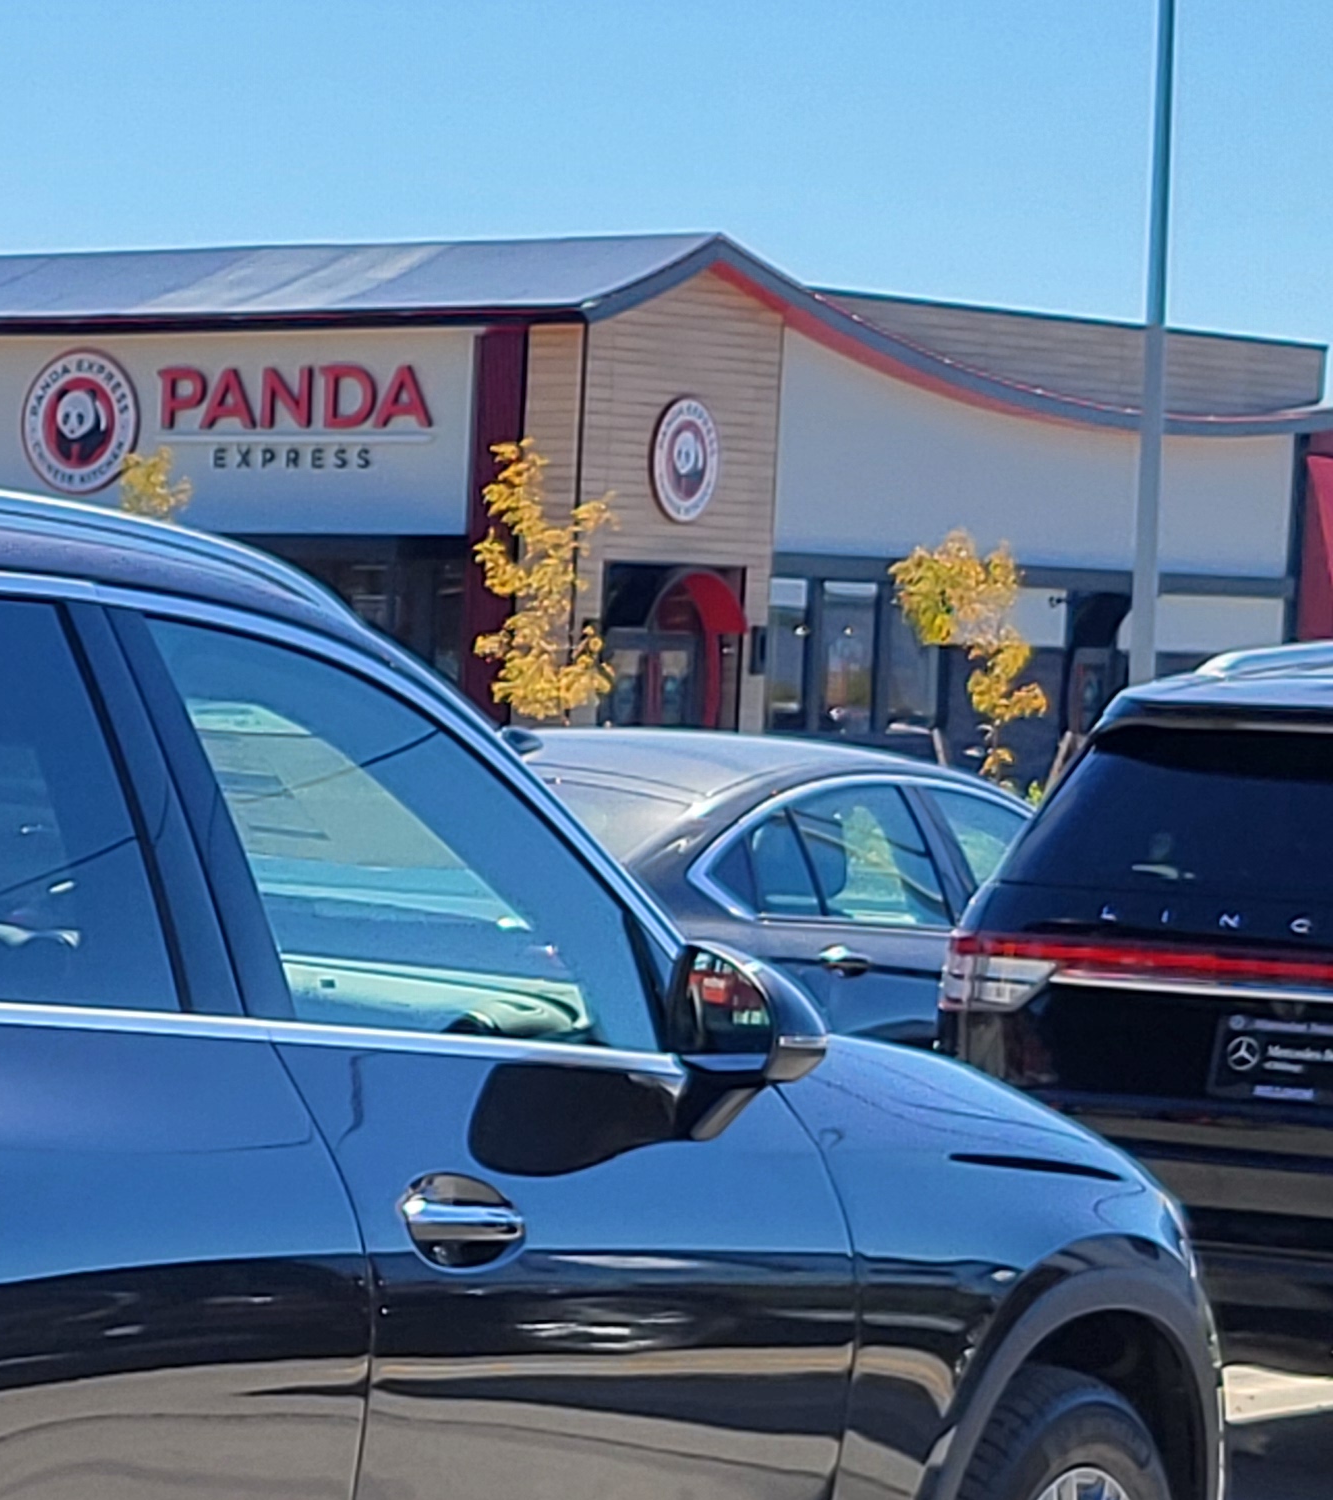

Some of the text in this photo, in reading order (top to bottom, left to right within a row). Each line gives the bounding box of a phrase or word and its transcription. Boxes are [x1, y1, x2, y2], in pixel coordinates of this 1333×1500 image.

[31, 359, 129, 416] PANDA EXPRESS
[157, 364, 433, 430] PANDA
[213, 448, 373, 469] EXPRESS
